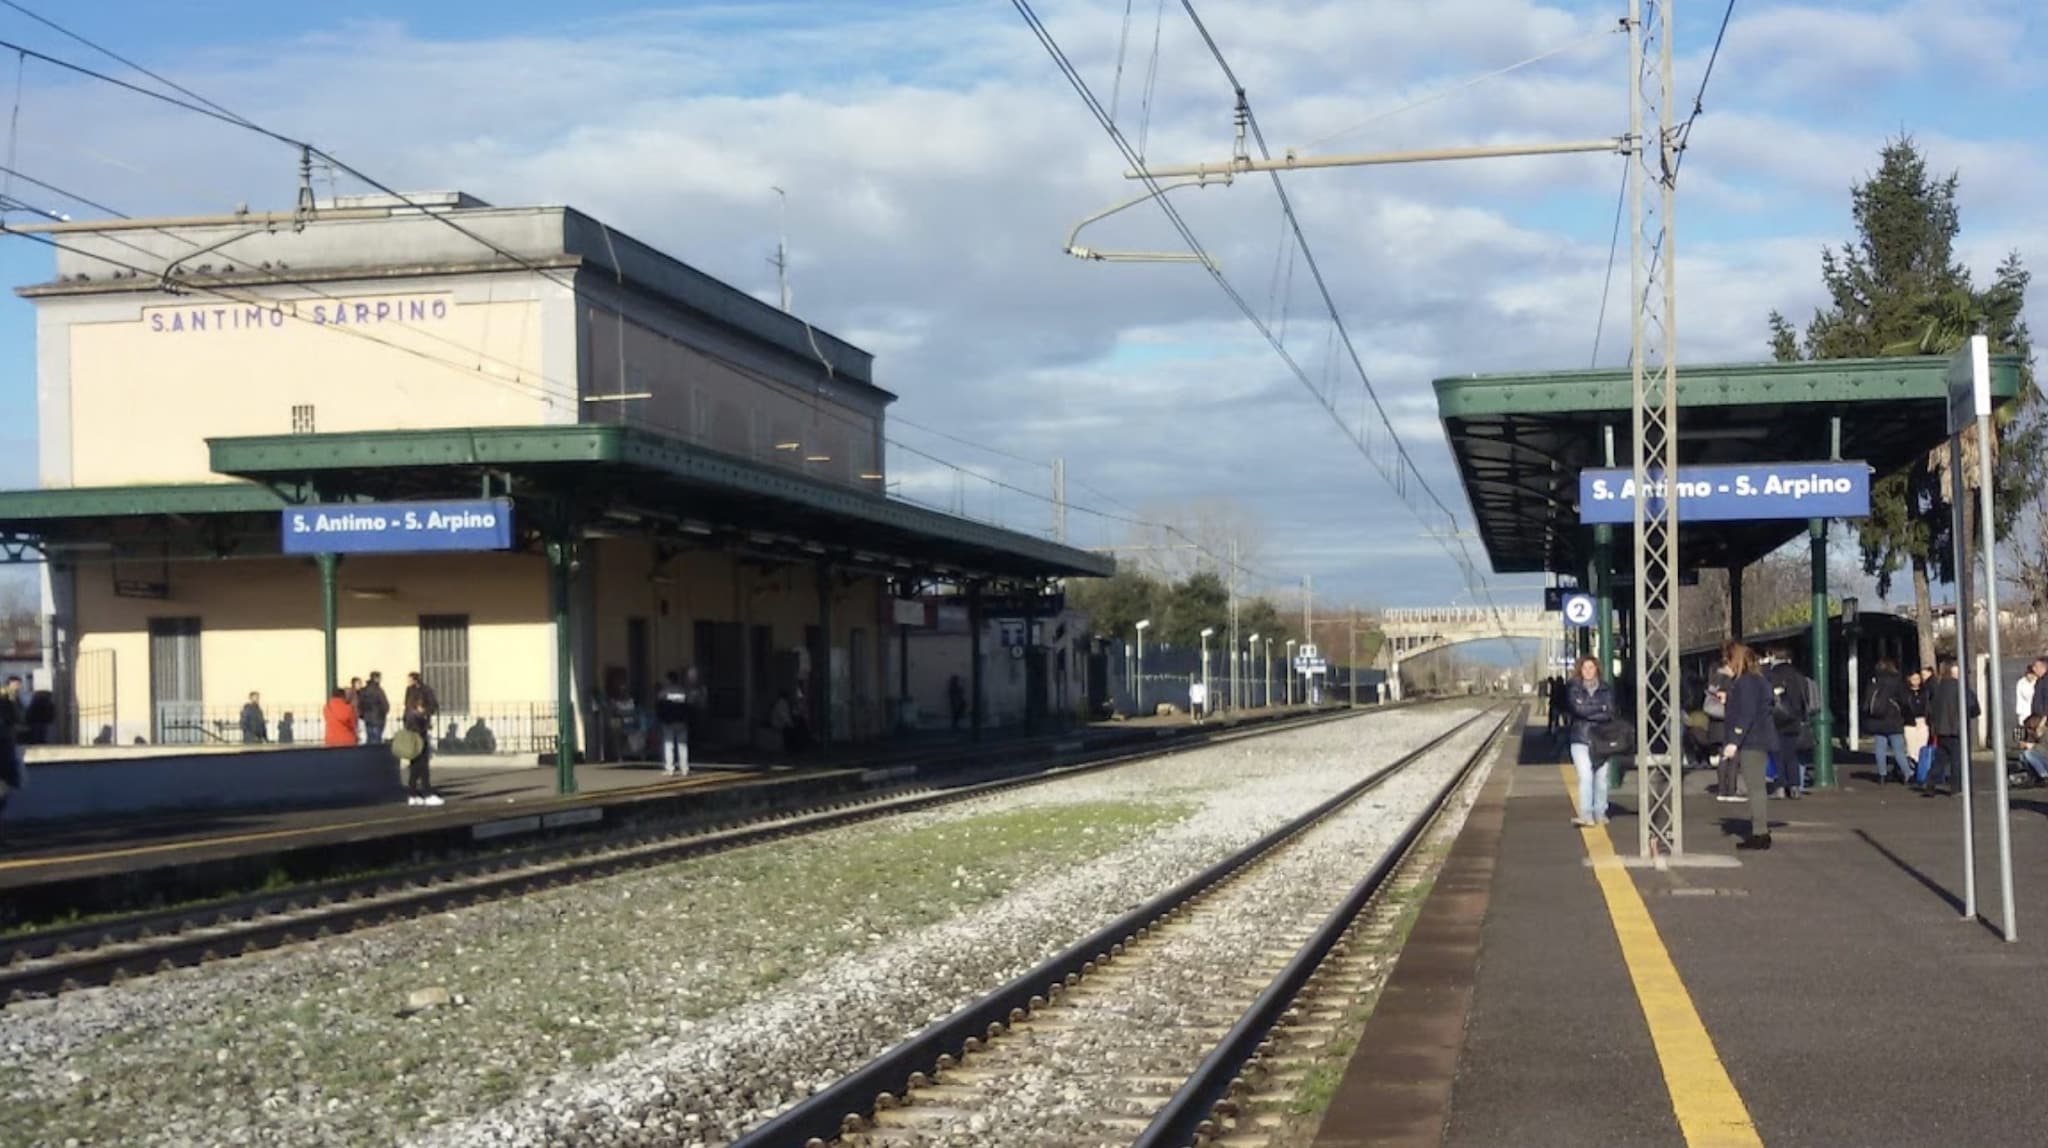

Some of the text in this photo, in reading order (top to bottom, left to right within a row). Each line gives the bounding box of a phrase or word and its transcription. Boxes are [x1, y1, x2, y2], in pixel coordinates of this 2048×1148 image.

[1592, 473, 1852, 500] S. Antimo - S. Arpino
[293, 513, 311, 533] S.
[315, 513, 387, 532] Antimo
[404, 511, 423, 530] S.
[427, 509, 496, 533] Arpino
[1573, 602, 1586, 618] 2
